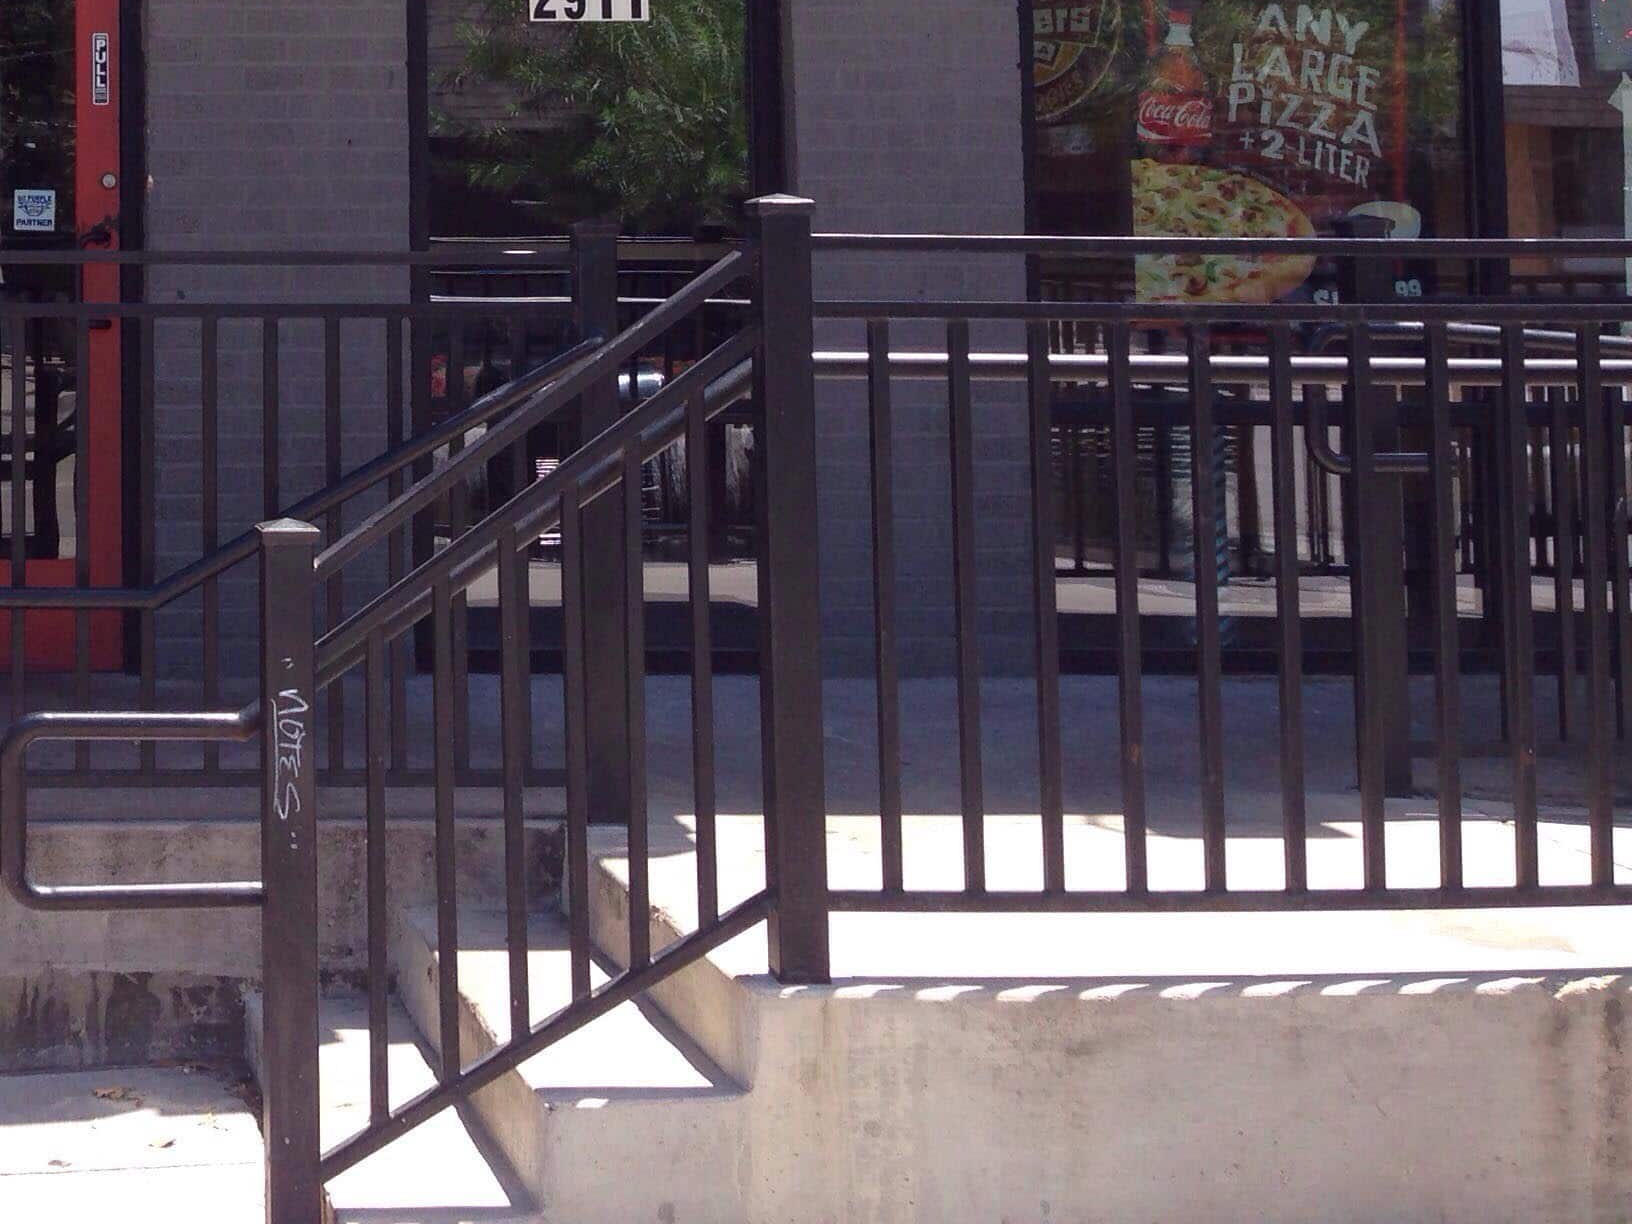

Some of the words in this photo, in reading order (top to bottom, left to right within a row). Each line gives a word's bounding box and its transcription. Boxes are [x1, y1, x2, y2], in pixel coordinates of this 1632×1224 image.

[1253, 2, 1369, 55] ANY
[95, 39, 107, 88] PULL
[1231, 42, 1381, 113] LARGE
